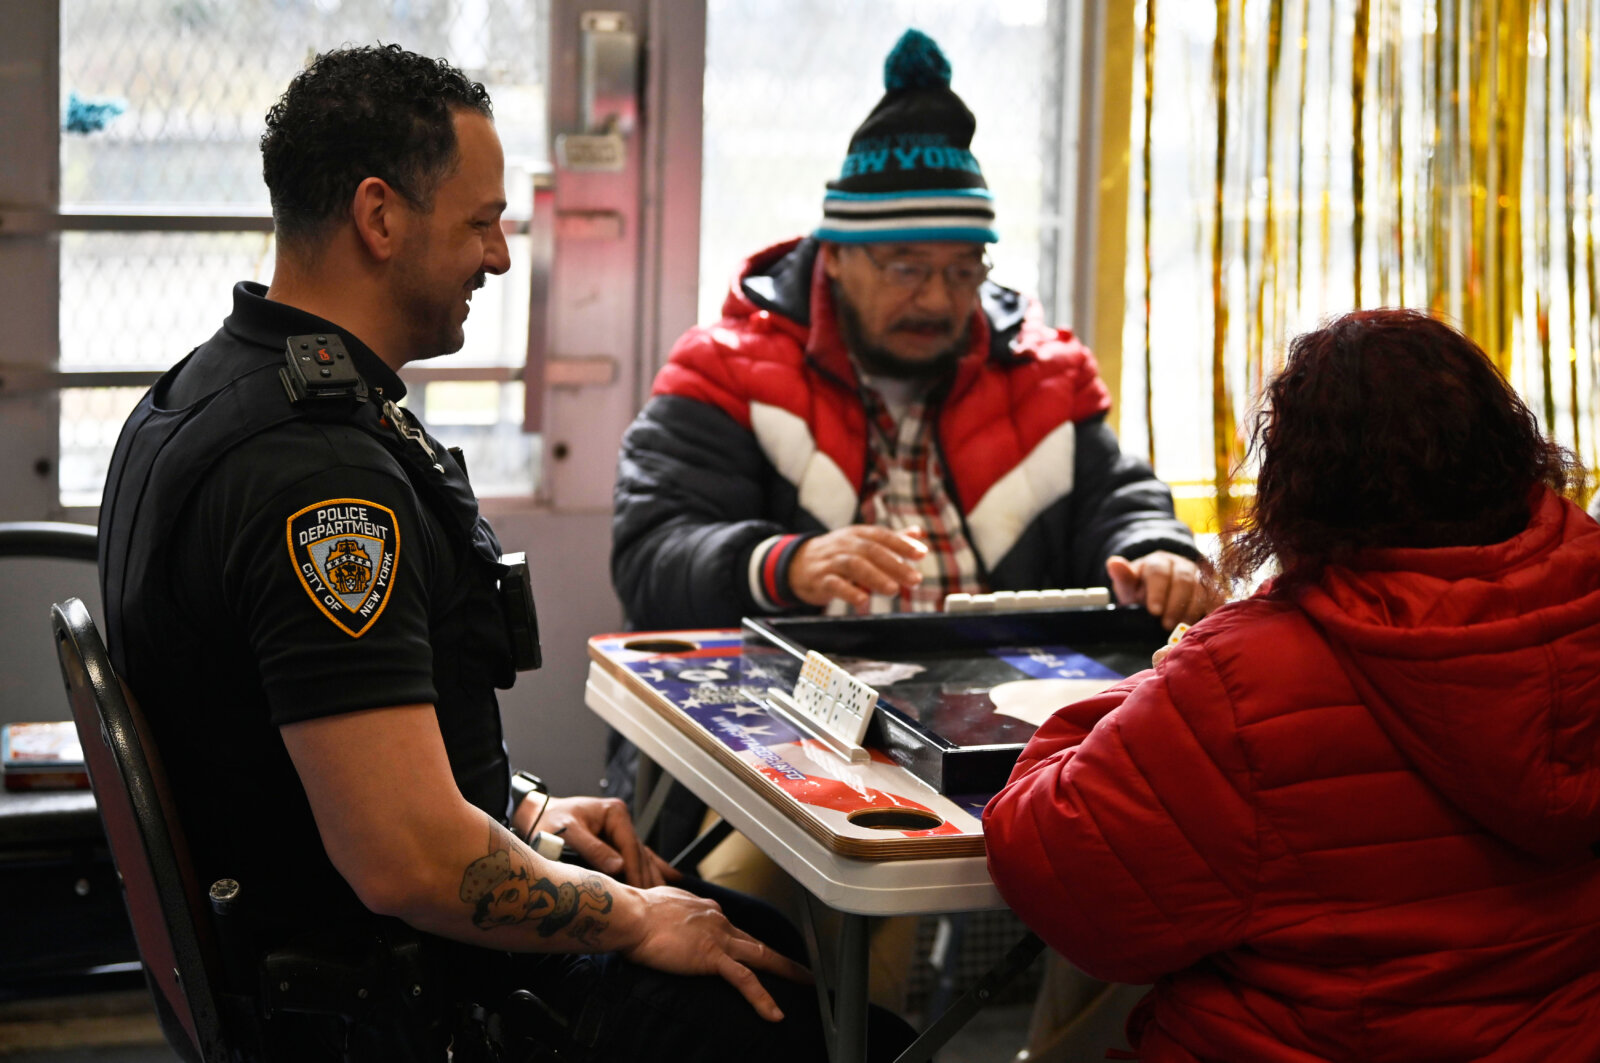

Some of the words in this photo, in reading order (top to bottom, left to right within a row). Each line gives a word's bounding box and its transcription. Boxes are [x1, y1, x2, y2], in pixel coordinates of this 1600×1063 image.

[317, 507, 369, 524] POLICE
[299, 520, 389, 546] DEPARTMENT
[302, 563, 326, 592] CITY
[324, 594, 343, 611] OF
[360, 590, 381, 618] NEW
[377, 552, 393, 587] YORK
